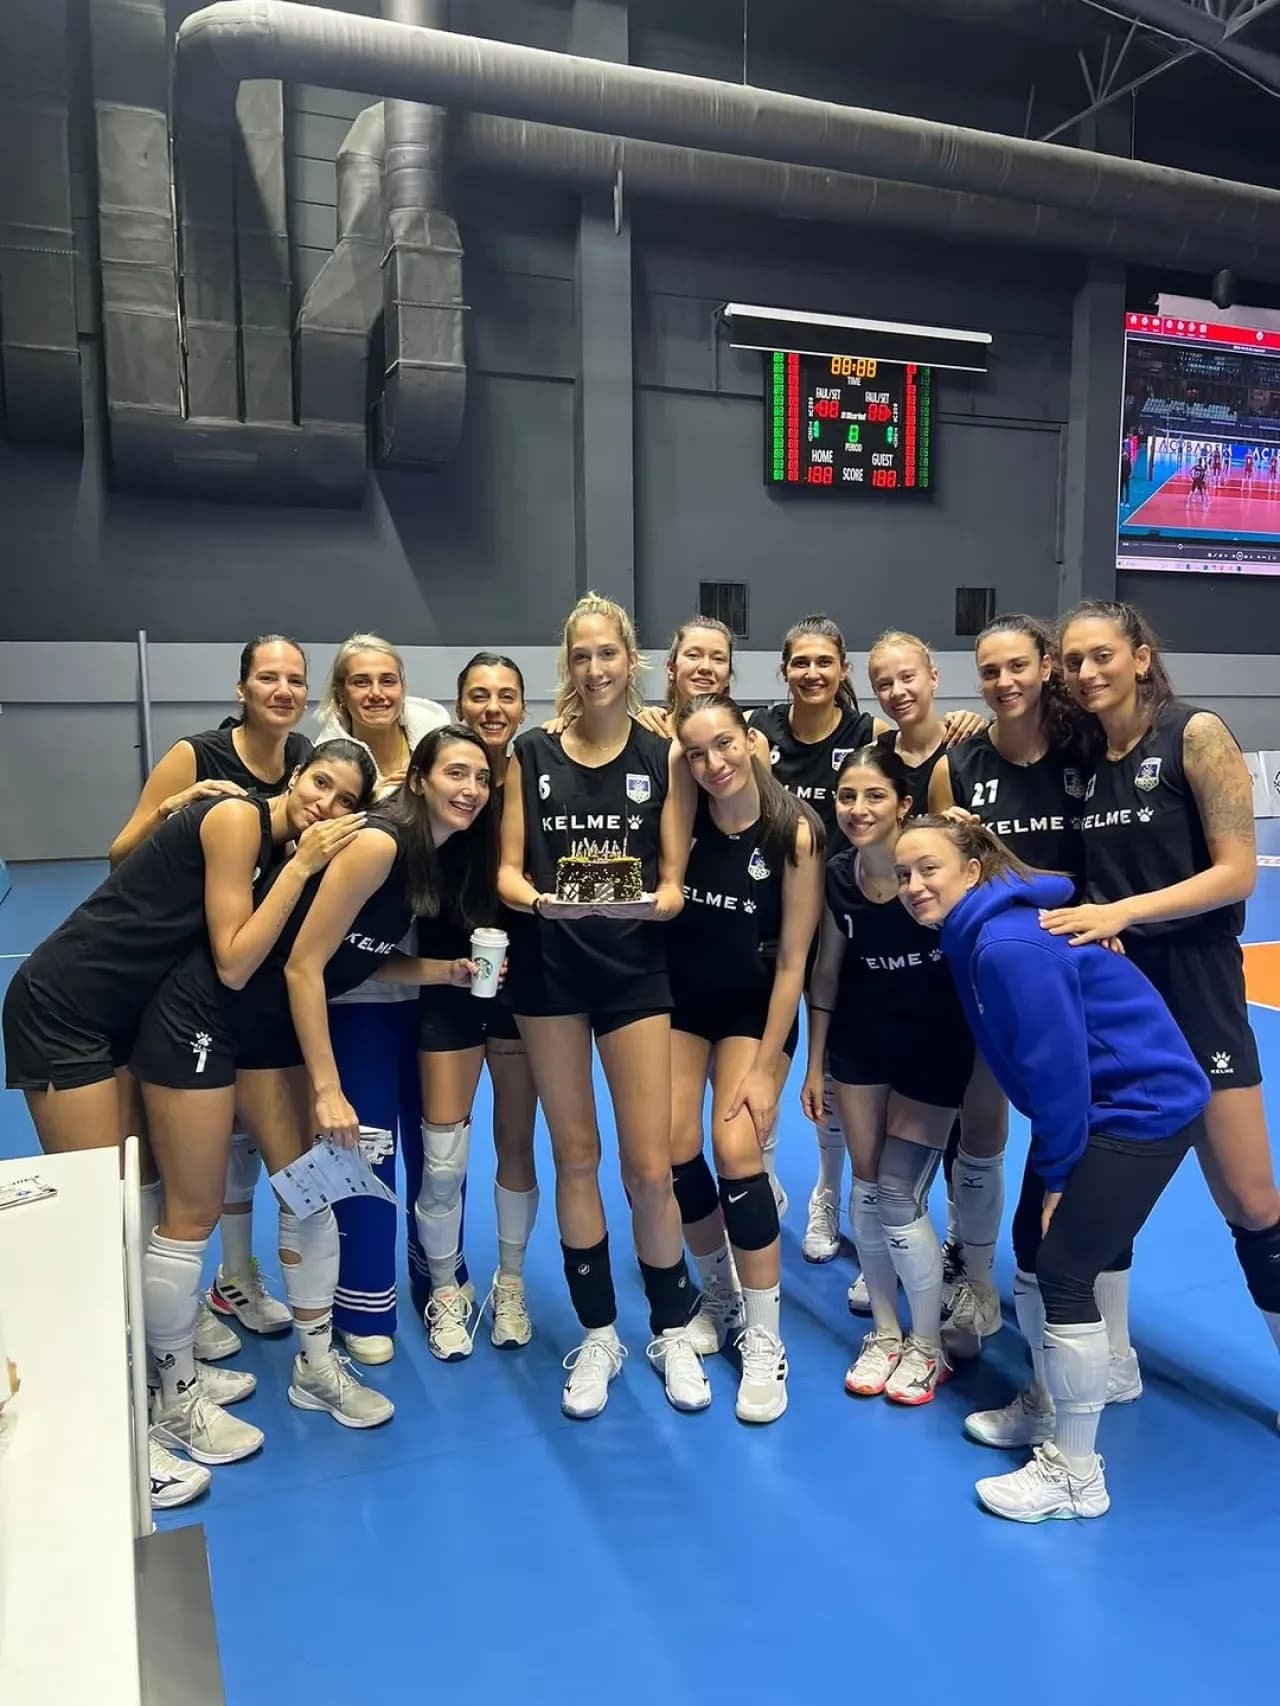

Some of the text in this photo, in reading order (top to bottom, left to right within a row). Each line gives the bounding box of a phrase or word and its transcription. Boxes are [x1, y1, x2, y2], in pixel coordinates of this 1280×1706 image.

[848, 424, 859, 443] 8
[811, 449, 833, 463] HOME
[871, 453, 894, 467] GUEST
[842, 467, 864, 482] SCORE
[538, 774, 551, 800] 6
[542, 814, 621, 832] KELME
